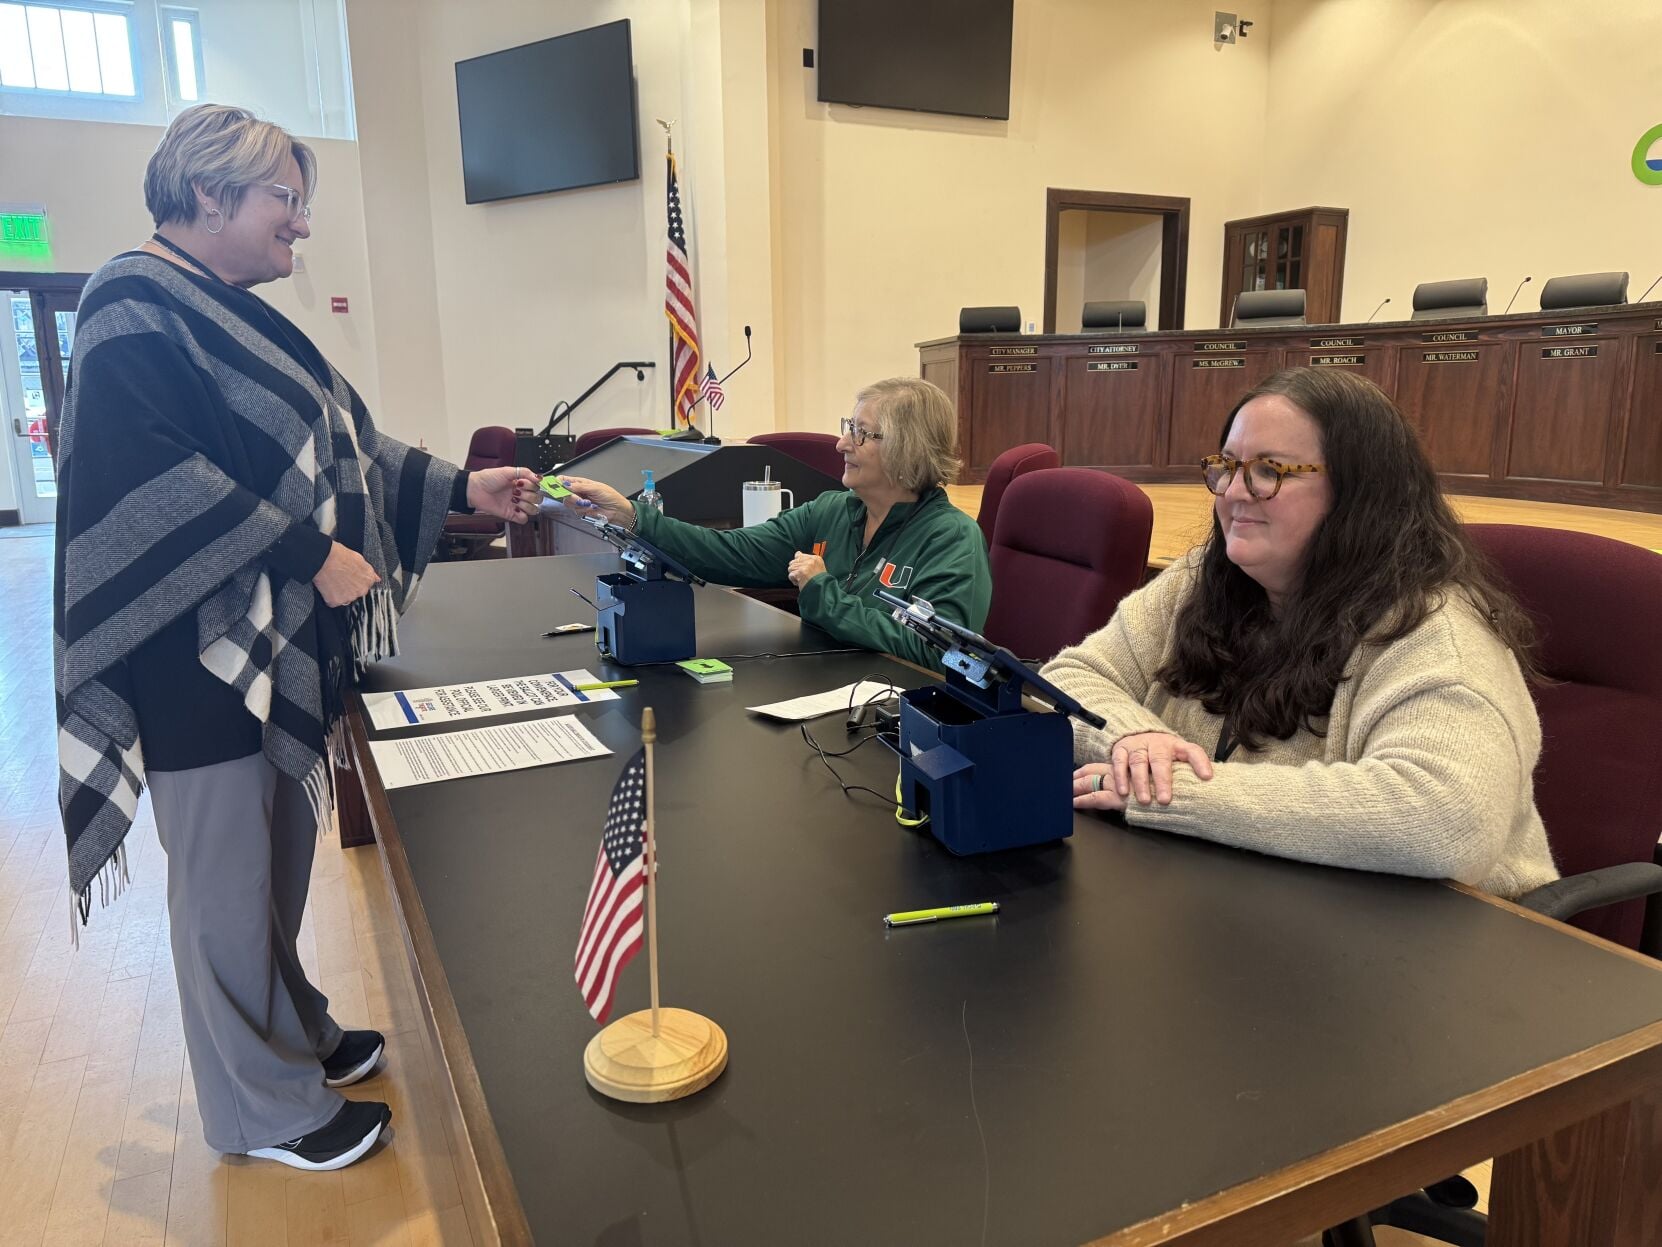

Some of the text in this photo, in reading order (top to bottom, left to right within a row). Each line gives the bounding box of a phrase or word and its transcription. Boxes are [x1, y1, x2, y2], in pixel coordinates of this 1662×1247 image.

[2, 216, 41, 240] EXIT
[1555, 326, 1582, 335] MAYOR
[1432, 333, 1467, 341] COUNCIL
[1439, 352, 1476, 360] WATERMAN
[1564, 348, 1589, 356] GRANT
[879, 562, 913, 589] U
